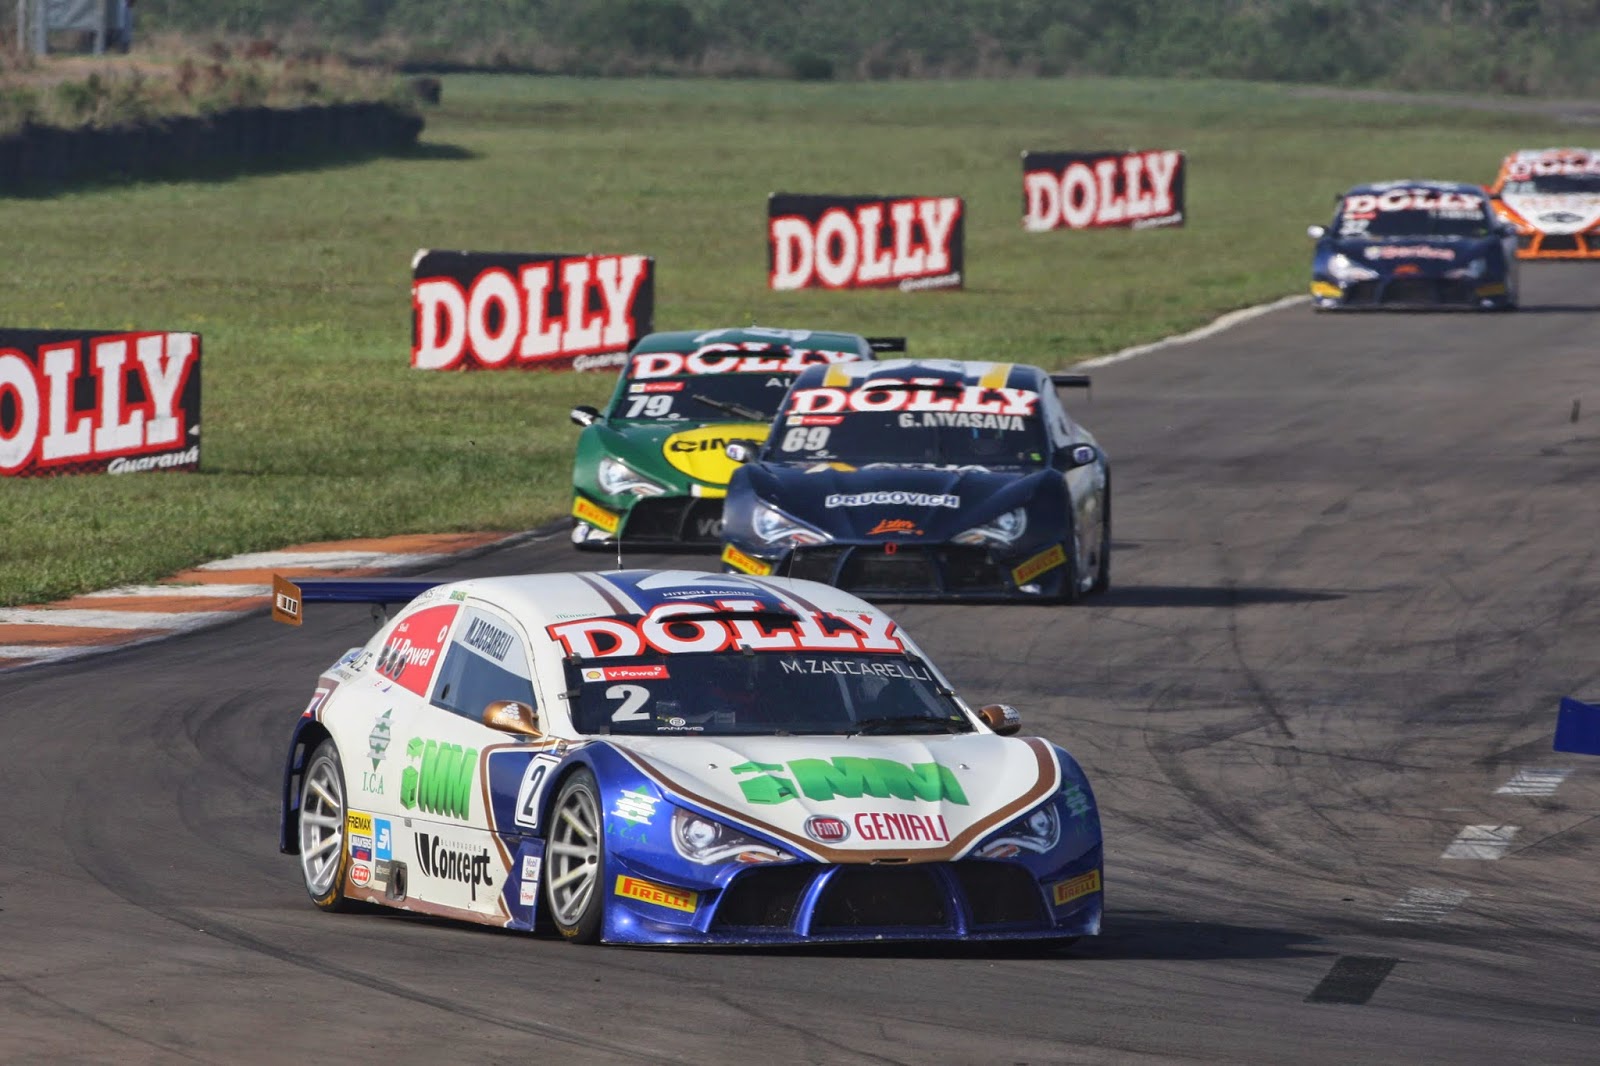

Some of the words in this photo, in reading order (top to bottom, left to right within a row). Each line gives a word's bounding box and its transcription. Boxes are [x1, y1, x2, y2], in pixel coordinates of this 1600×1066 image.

[1022, 150, 1179, 232] DOLLY
[1344, 189, 1483, 212] DOLLY
[769, 197, 960, 290] DOLLY
[413, 256, 646, 369] DOLLY
[629, 342, 865, 378] DOLLY
[0, 332, 192, 470] OLLY
[625, 395, 674, 418] 79
[784, 378, 1040, 416] DOLLY
[781, 426, 831, 452] 69
[107, 446, 199, 476] Guaraná
[825, 491, 961, 509] DRUGOVICH
[546, 599, 906, 659] DOLLY
[608, 668, 660, 678] V-Power
[780, 660, 933, 682] M.ZACCARELLI
[605, 684, 650, 722] 2
[523, 765, 546, 817] 2
[347, 815, 372, 832] FREMAX
[817, 823, 841, 837] FIAT
[855, 812, 950, 842] GENIALI
[622, 877, 692, 908] PIRELLI
[1056, 872, 1097, 902] PIRELLI
